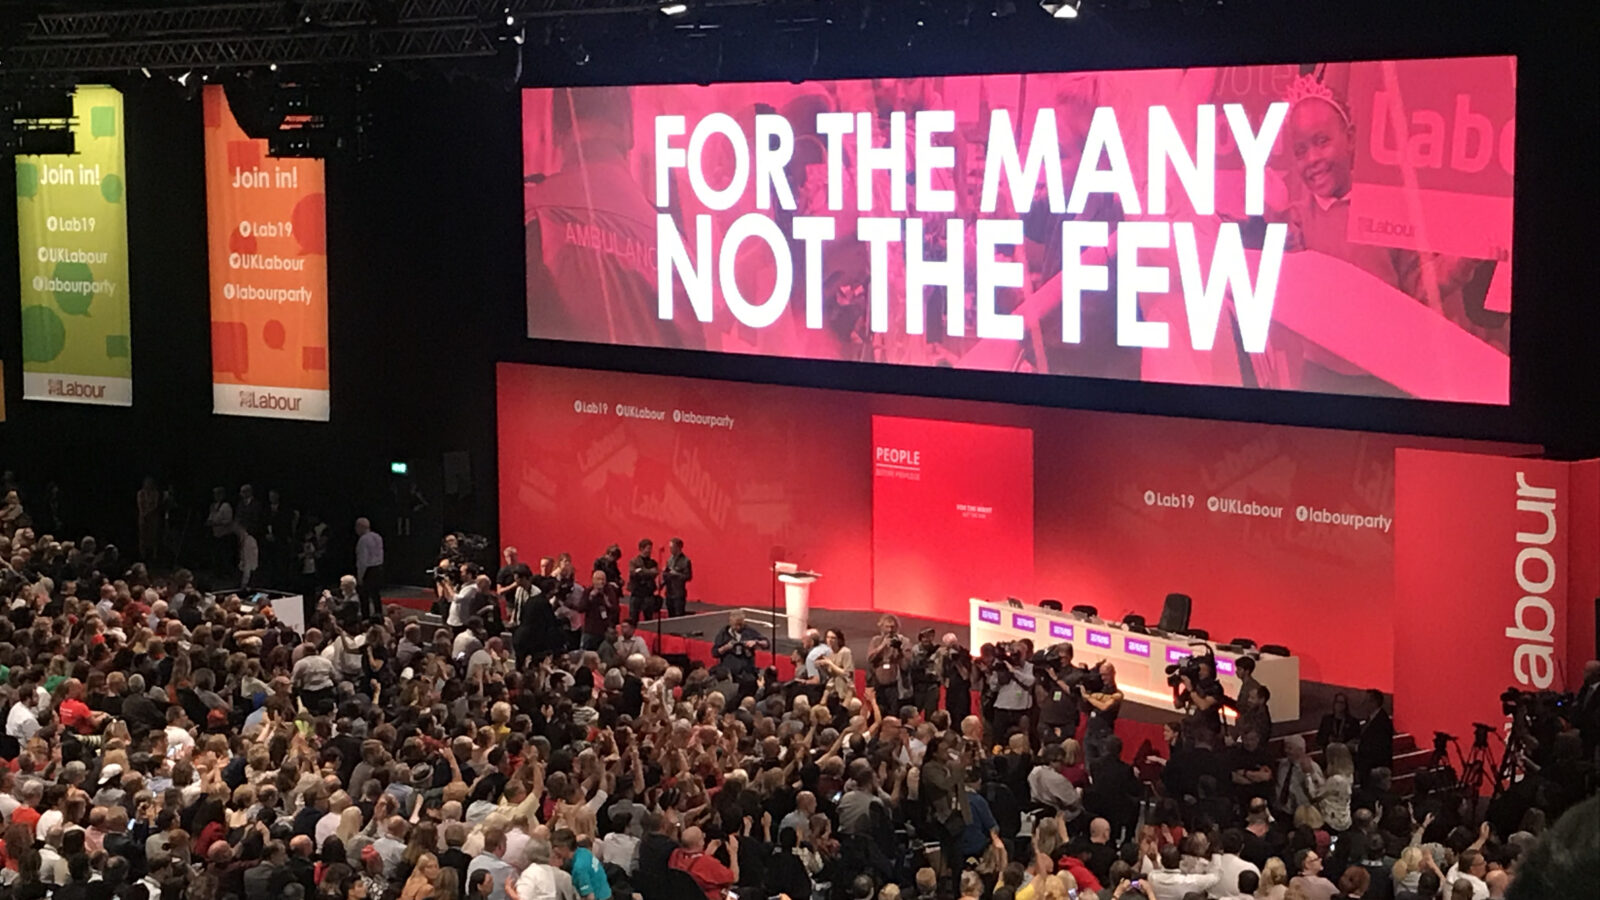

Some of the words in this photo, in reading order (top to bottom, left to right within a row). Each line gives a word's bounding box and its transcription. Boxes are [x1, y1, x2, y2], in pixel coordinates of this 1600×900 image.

[654, 112, 798, 212] FOR
[817, 110, 956, 213] THE
[980, 101, 1289, 215] MANY
[40, 164, 74, 186] Join
[78, 164, 100, 185] in!
[232, 167, 270, 189] Join
[276, 167, 298, 188] in!
[60, 217, 96, 233] Lab19
[253, 221, 293, 238] Lab19
[49, 248, 108, 264] UKLabour
[241, 254, 305, 271] UKLabour
[44, 276, 115, 297] labourparty
[236, 283, 312, 305] labourparty
[656, 213, 836, 329] NOT
[857, 217, 1024, 341] THE
[1061, 220, 1288, 354] FEW
[60, 381, 106, 399] Labour
[251, 392, 302, 412] Labour
[583, 401, 608, 415] Lab19
[624, 405, 666, 421] UKLabour
[681, 413, 735, 430] labourparty
[876, 446, 921, 466] PEOPLE
[1157, 492, 1195, 509] Lab19
[1220, 497, 1283, 518] UKLabour
[1309, 508, 1393, 532] labourparty
[1505, 471, 1557, 690] abour
